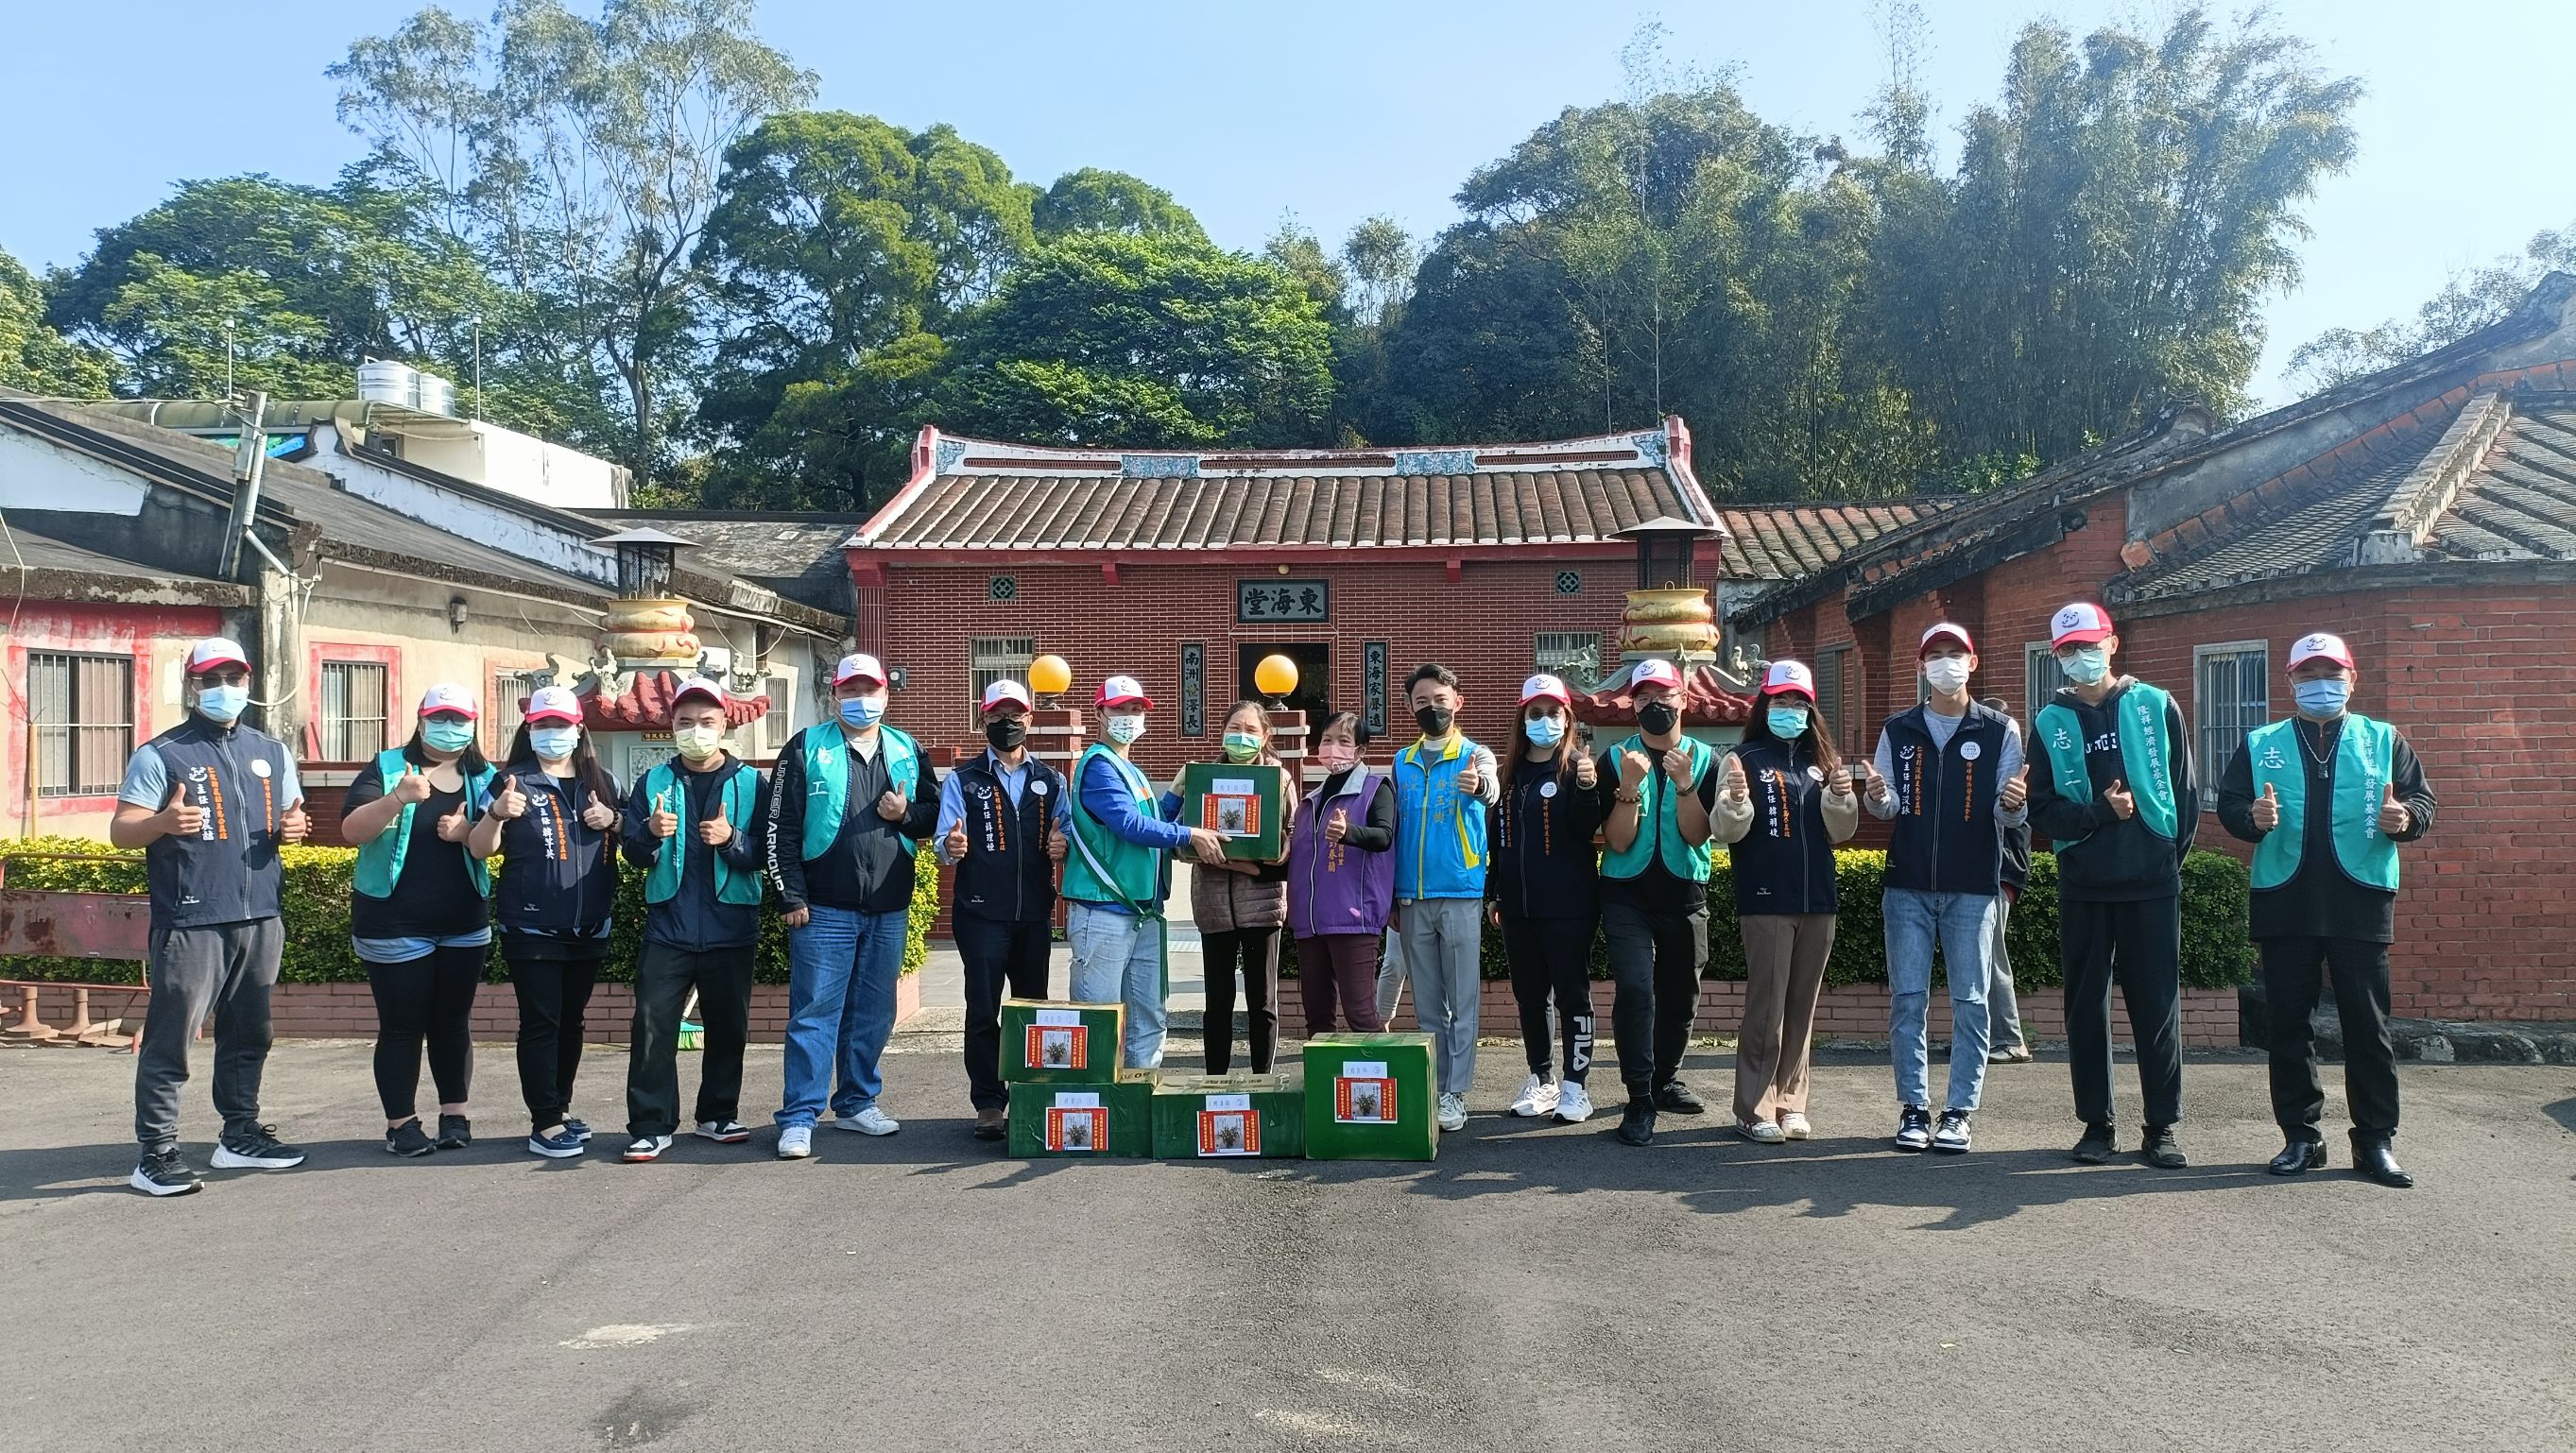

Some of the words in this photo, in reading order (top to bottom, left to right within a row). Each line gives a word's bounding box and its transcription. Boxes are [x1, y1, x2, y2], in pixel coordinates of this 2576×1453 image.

[1244, 587, 1323, 616] 東海堂
[1368, 650, 1383, 727] 東海家聲遠
[2137, 705, 2169, 801] 隆祥經濟發展基金會
[768, 760, 788, 819] UNDER
[1572, 1016, 1592, 1071] FILA
